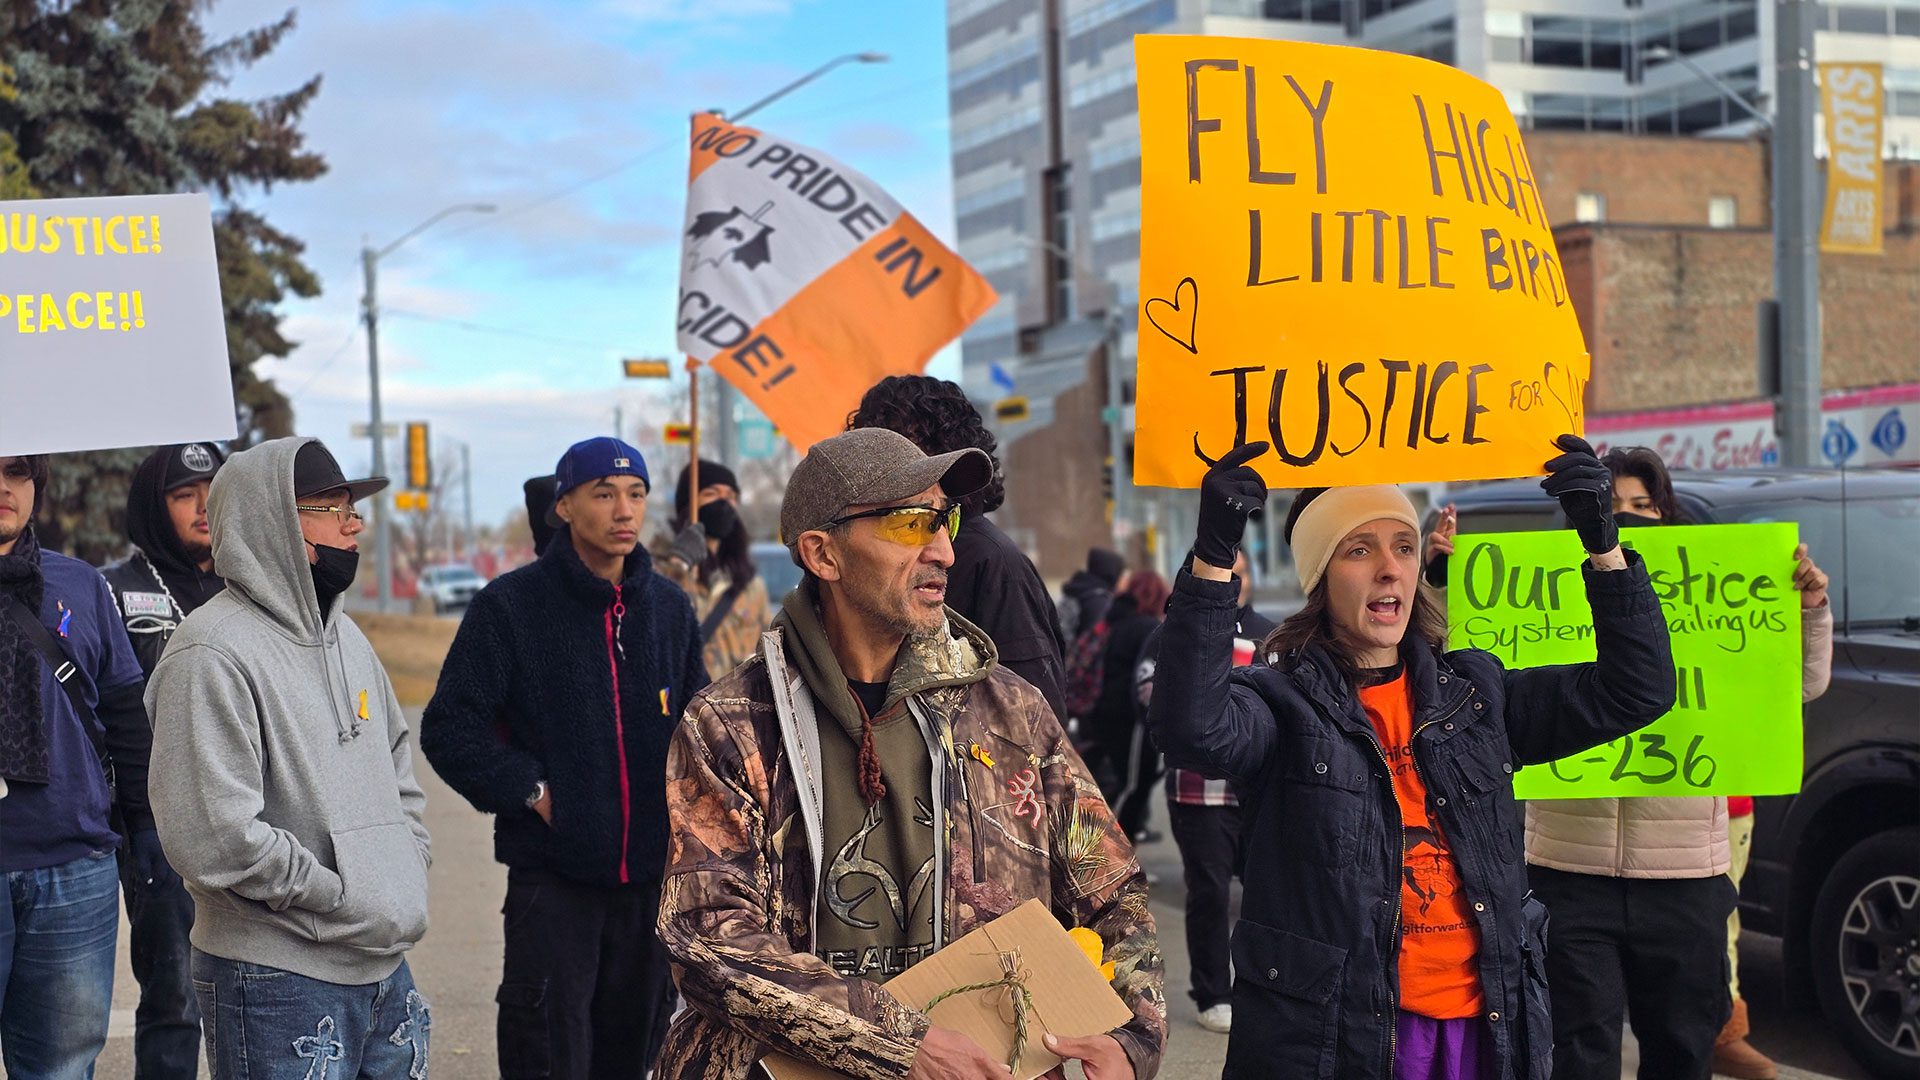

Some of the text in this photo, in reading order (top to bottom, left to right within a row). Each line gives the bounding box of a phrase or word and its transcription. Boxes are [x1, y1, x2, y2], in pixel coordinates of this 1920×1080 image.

[1184, 59, 1549, 231] FLY HIGH
[1828, 66, 1877, 182] ARTS
[692, 126, 942, 299] NO PRIDE IN
[1246, 209, 1567, 307] LITTLE BIRD
[678, 286, 796, 392] CIDE!
[1194, 358, 1495, 467] JUSTICE
[1509, 380, 1544, 411] FOR
[1464, 542, 1576, 611] Our
[1465, 613, 1595, 662] System
[1383, 742, 1411, 762] hild
